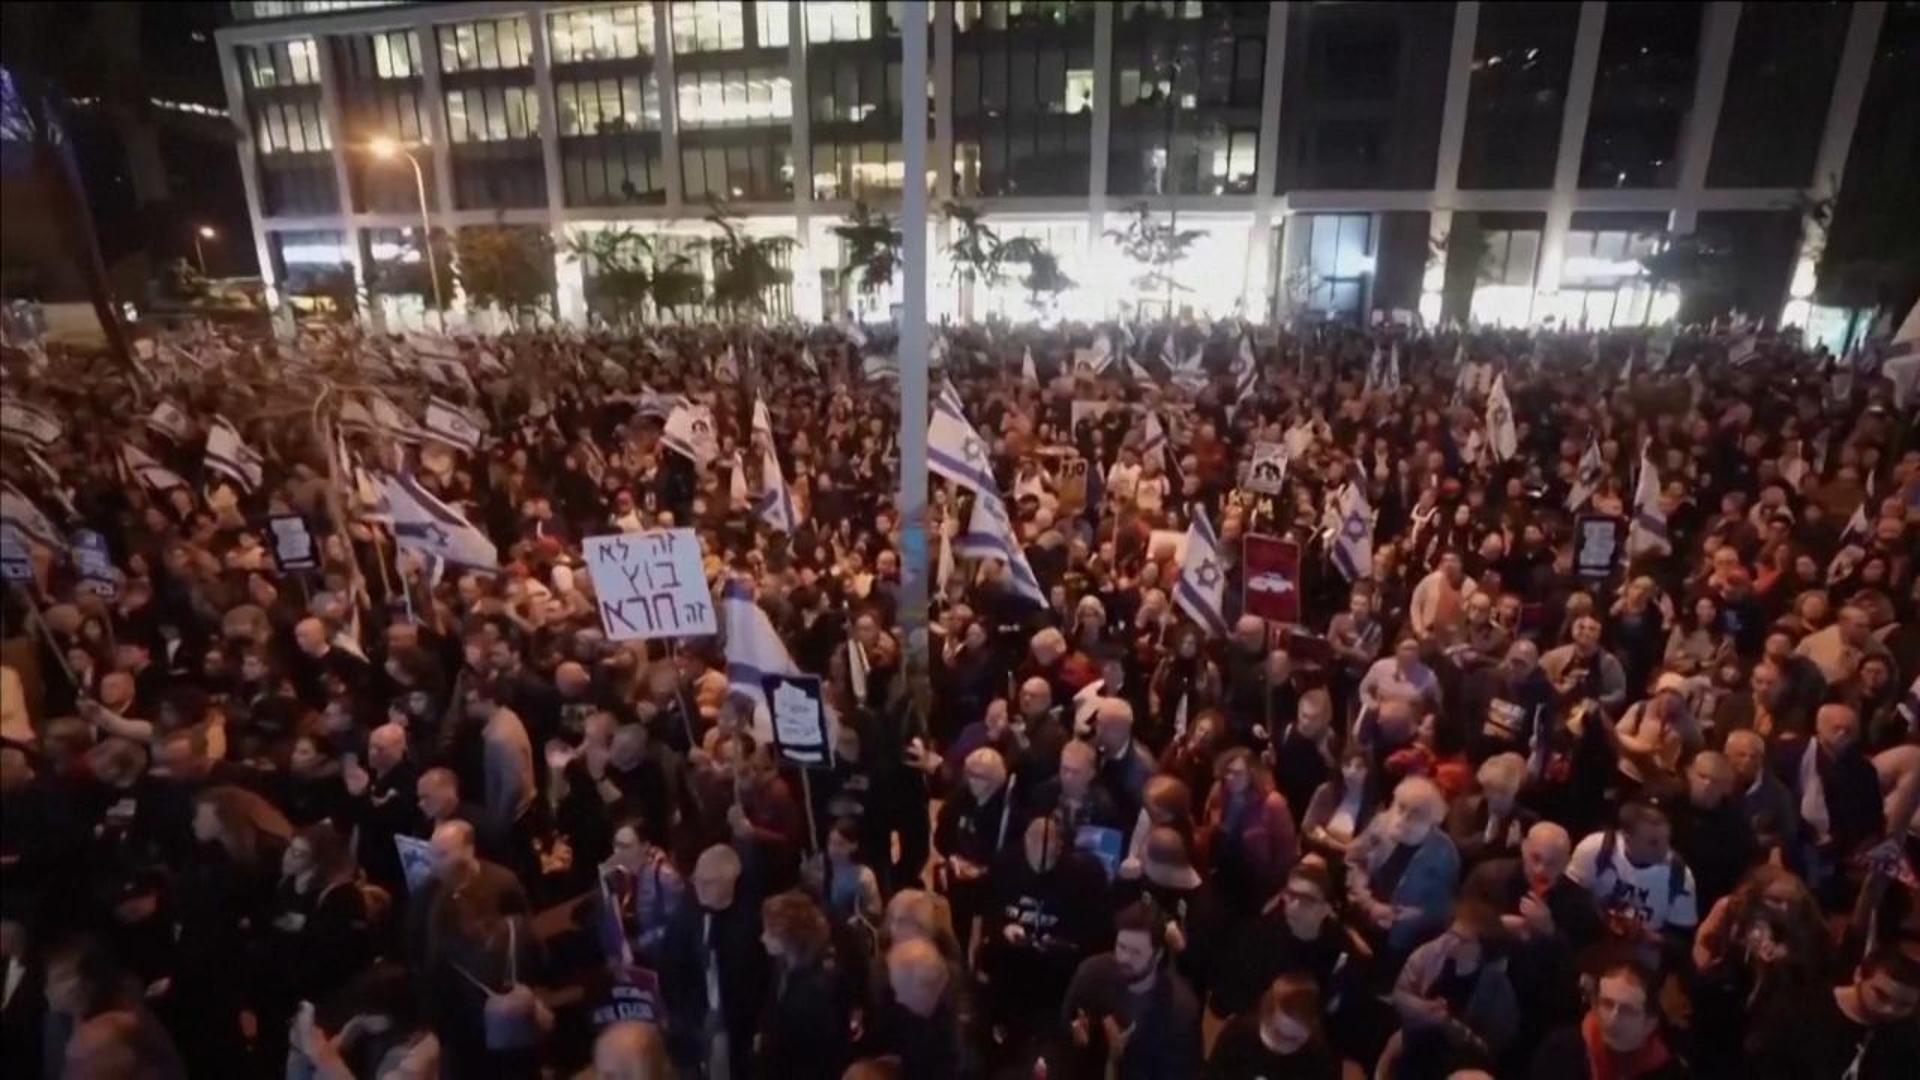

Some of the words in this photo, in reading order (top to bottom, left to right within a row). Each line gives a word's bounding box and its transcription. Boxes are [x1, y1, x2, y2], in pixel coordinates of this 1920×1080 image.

[599, 538, 629, 563] לא
[646, 531, 676, 556] זה
[621, 560, 682, 596] בוץ
[602, 592, 679, 633] חרא
[683, 601, 706, 624] זה
